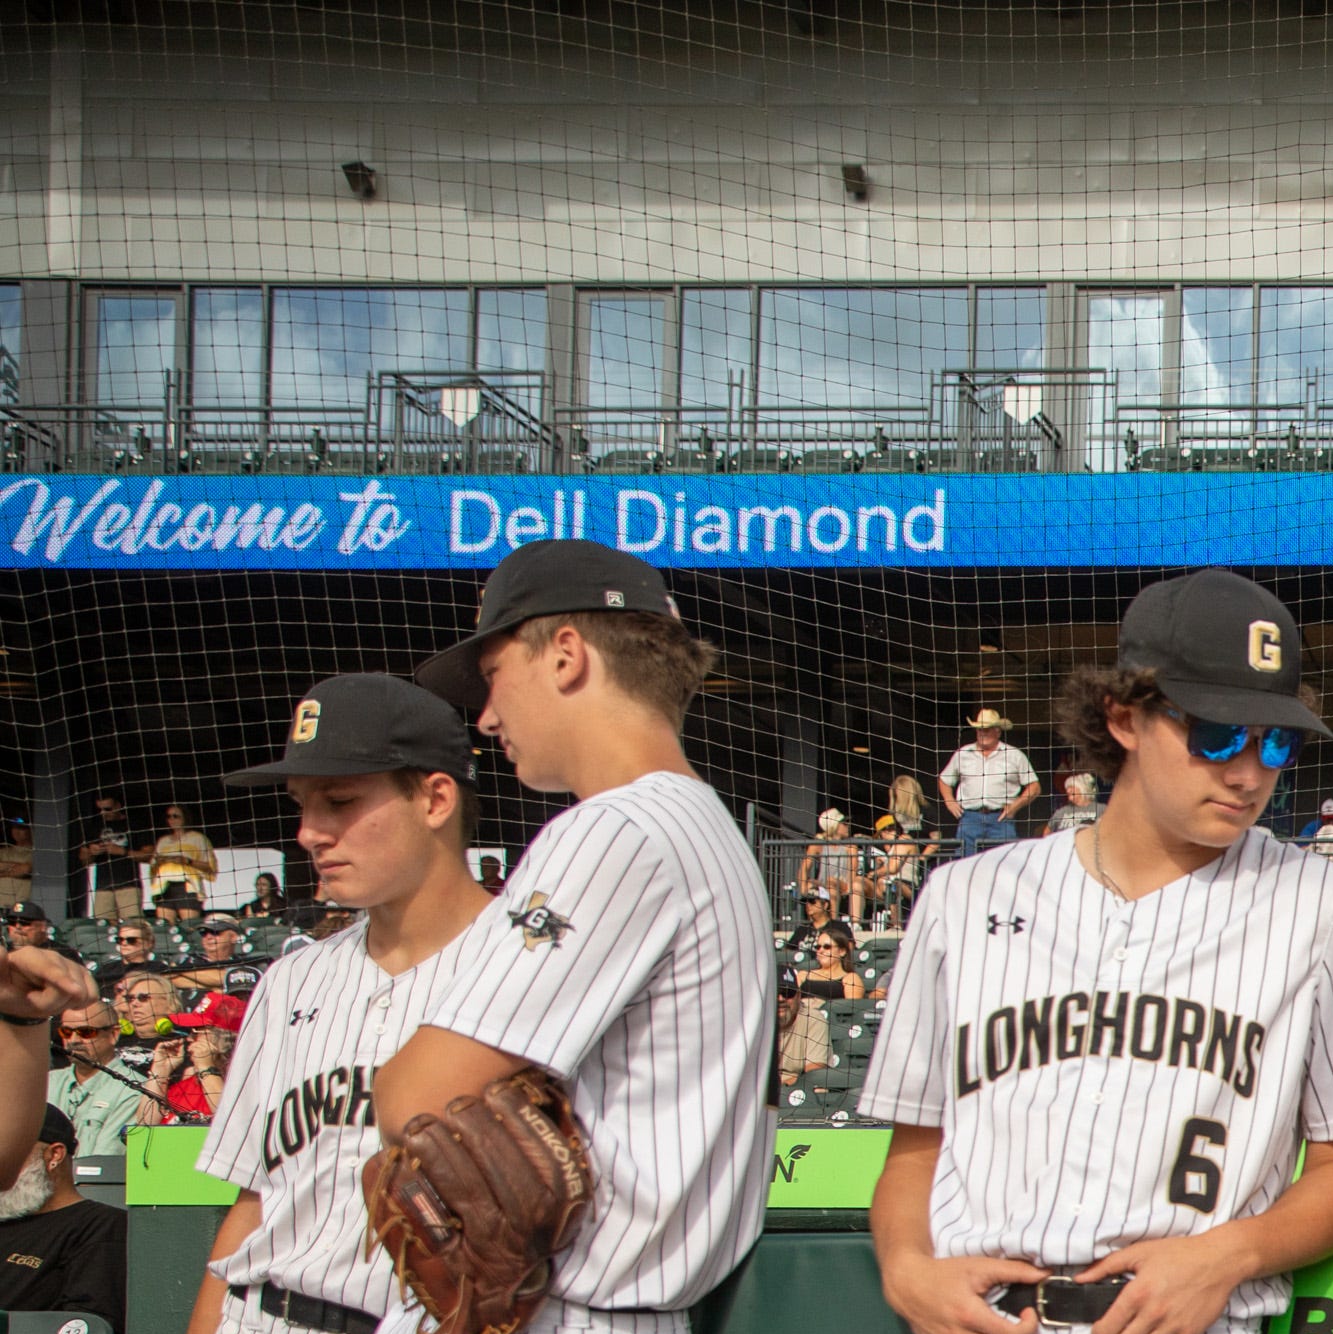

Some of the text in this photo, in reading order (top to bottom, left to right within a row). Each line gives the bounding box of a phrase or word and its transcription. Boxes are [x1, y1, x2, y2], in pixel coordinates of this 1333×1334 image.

[0, 478, 946, 563] Welcome to Dell Diamond
[1248, 619, 1283, 673] G
[292, 699, 322, 743] G
[527, 908, 550, 929] G
[956, 991, 1266, 1099] LONGHORNS
[1168, 1116, 1227, 1214] 6
